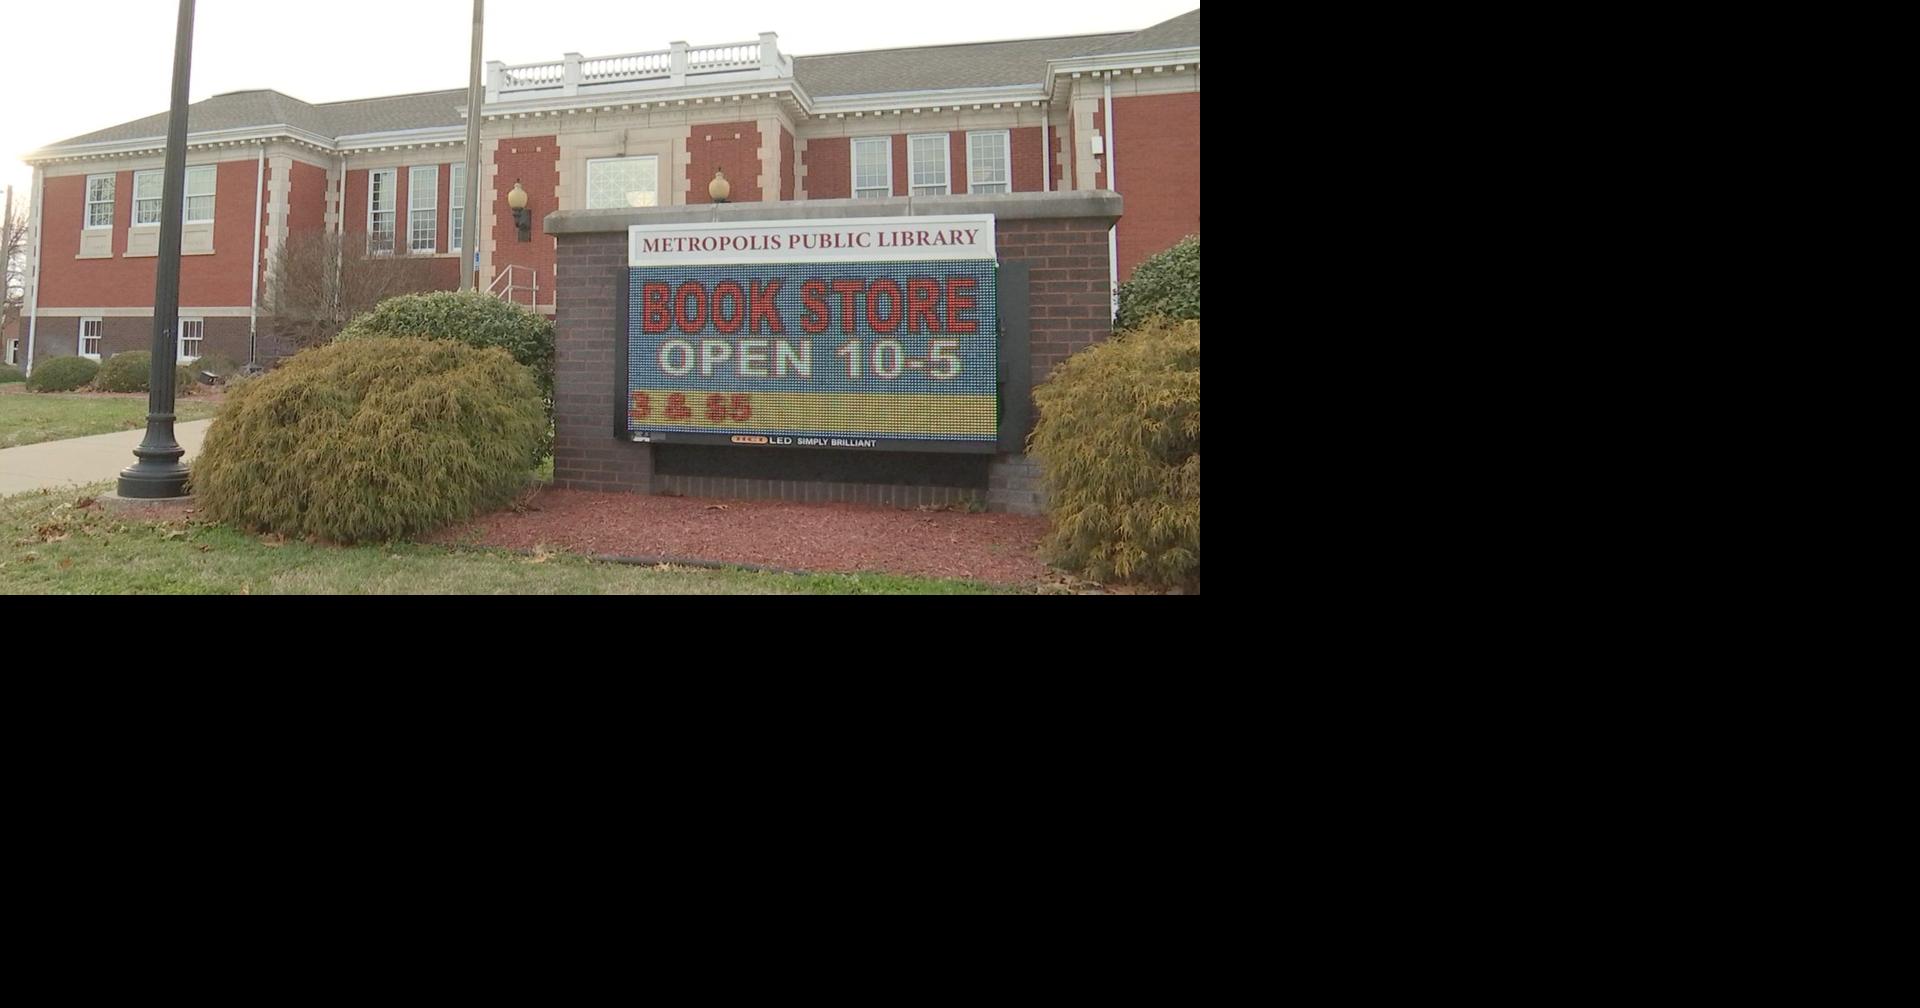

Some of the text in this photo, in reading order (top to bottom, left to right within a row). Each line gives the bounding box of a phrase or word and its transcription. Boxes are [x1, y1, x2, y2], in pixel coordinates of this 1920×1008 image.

[642, 228, 980, 253] METROPOLIS PUBLIC LIBRARY
[641, 278, 978, 334] BOOK STORE
[657, 338, 964, 379] OPEN 10-5
[663, 391, 692, 420] &
[704, 392, 752, 422] $5
[769, 436, 792, 444] LED
[797, 437, 829, 446] SIMPLY
[831, 439, 877, 447] BRILLIANT
